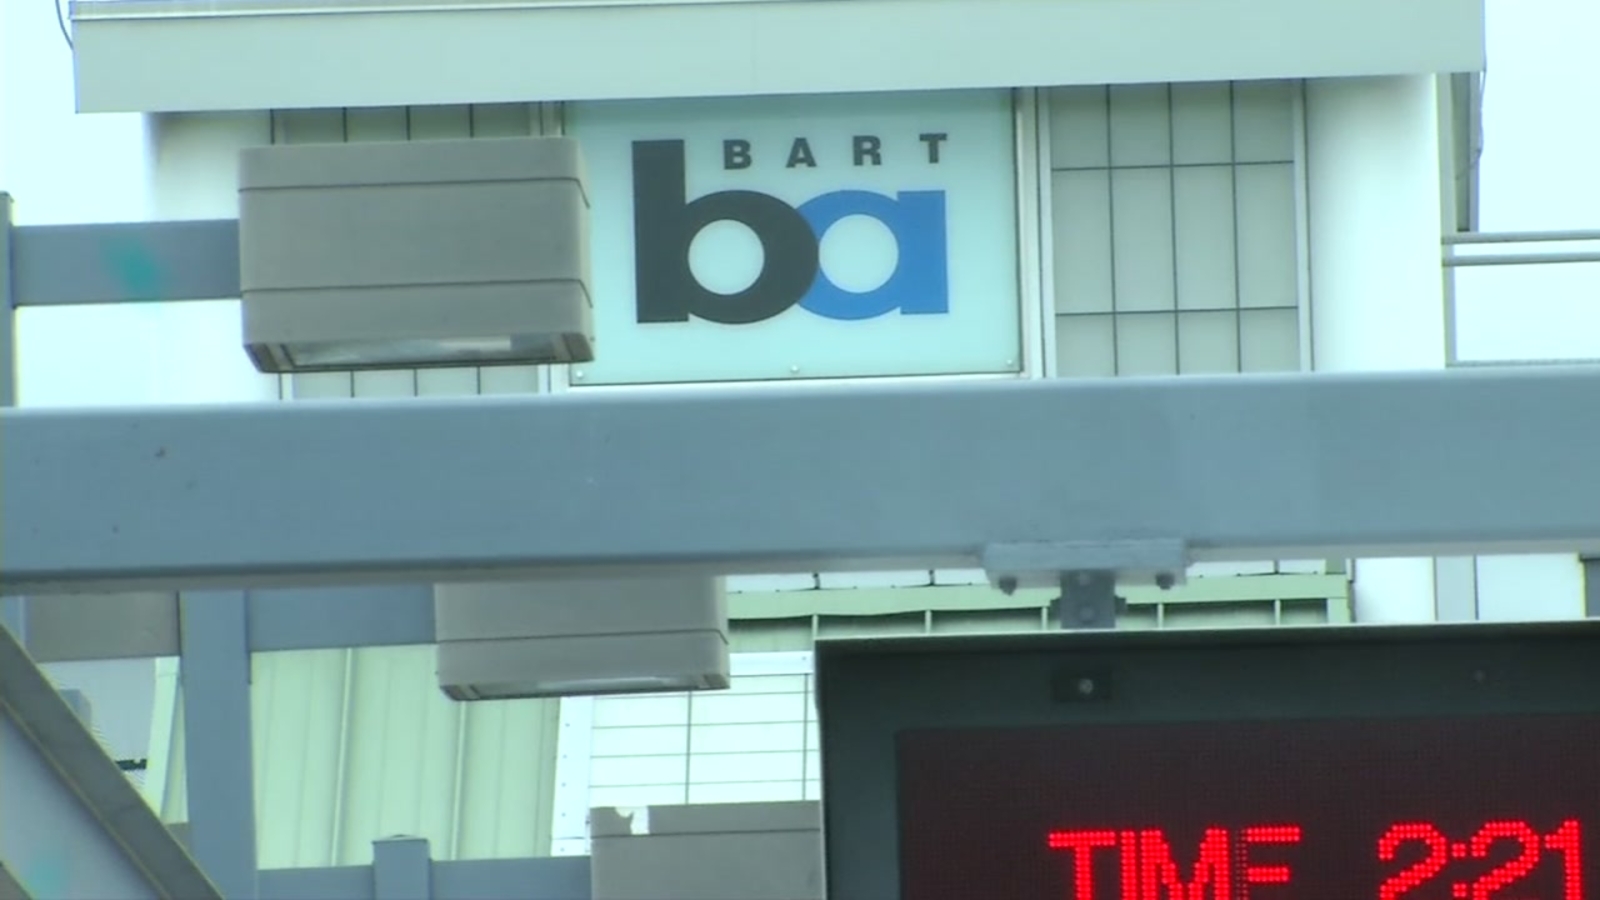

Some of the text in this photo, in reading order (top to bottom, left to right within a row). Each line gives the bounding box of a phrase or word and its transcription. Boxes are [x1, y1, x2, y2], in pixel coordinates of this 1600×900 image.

[722, 132, 948, 170] BART
[631, 138, 949, 325] ba
[1048, 819, 1583, 900] TIME 2:21
